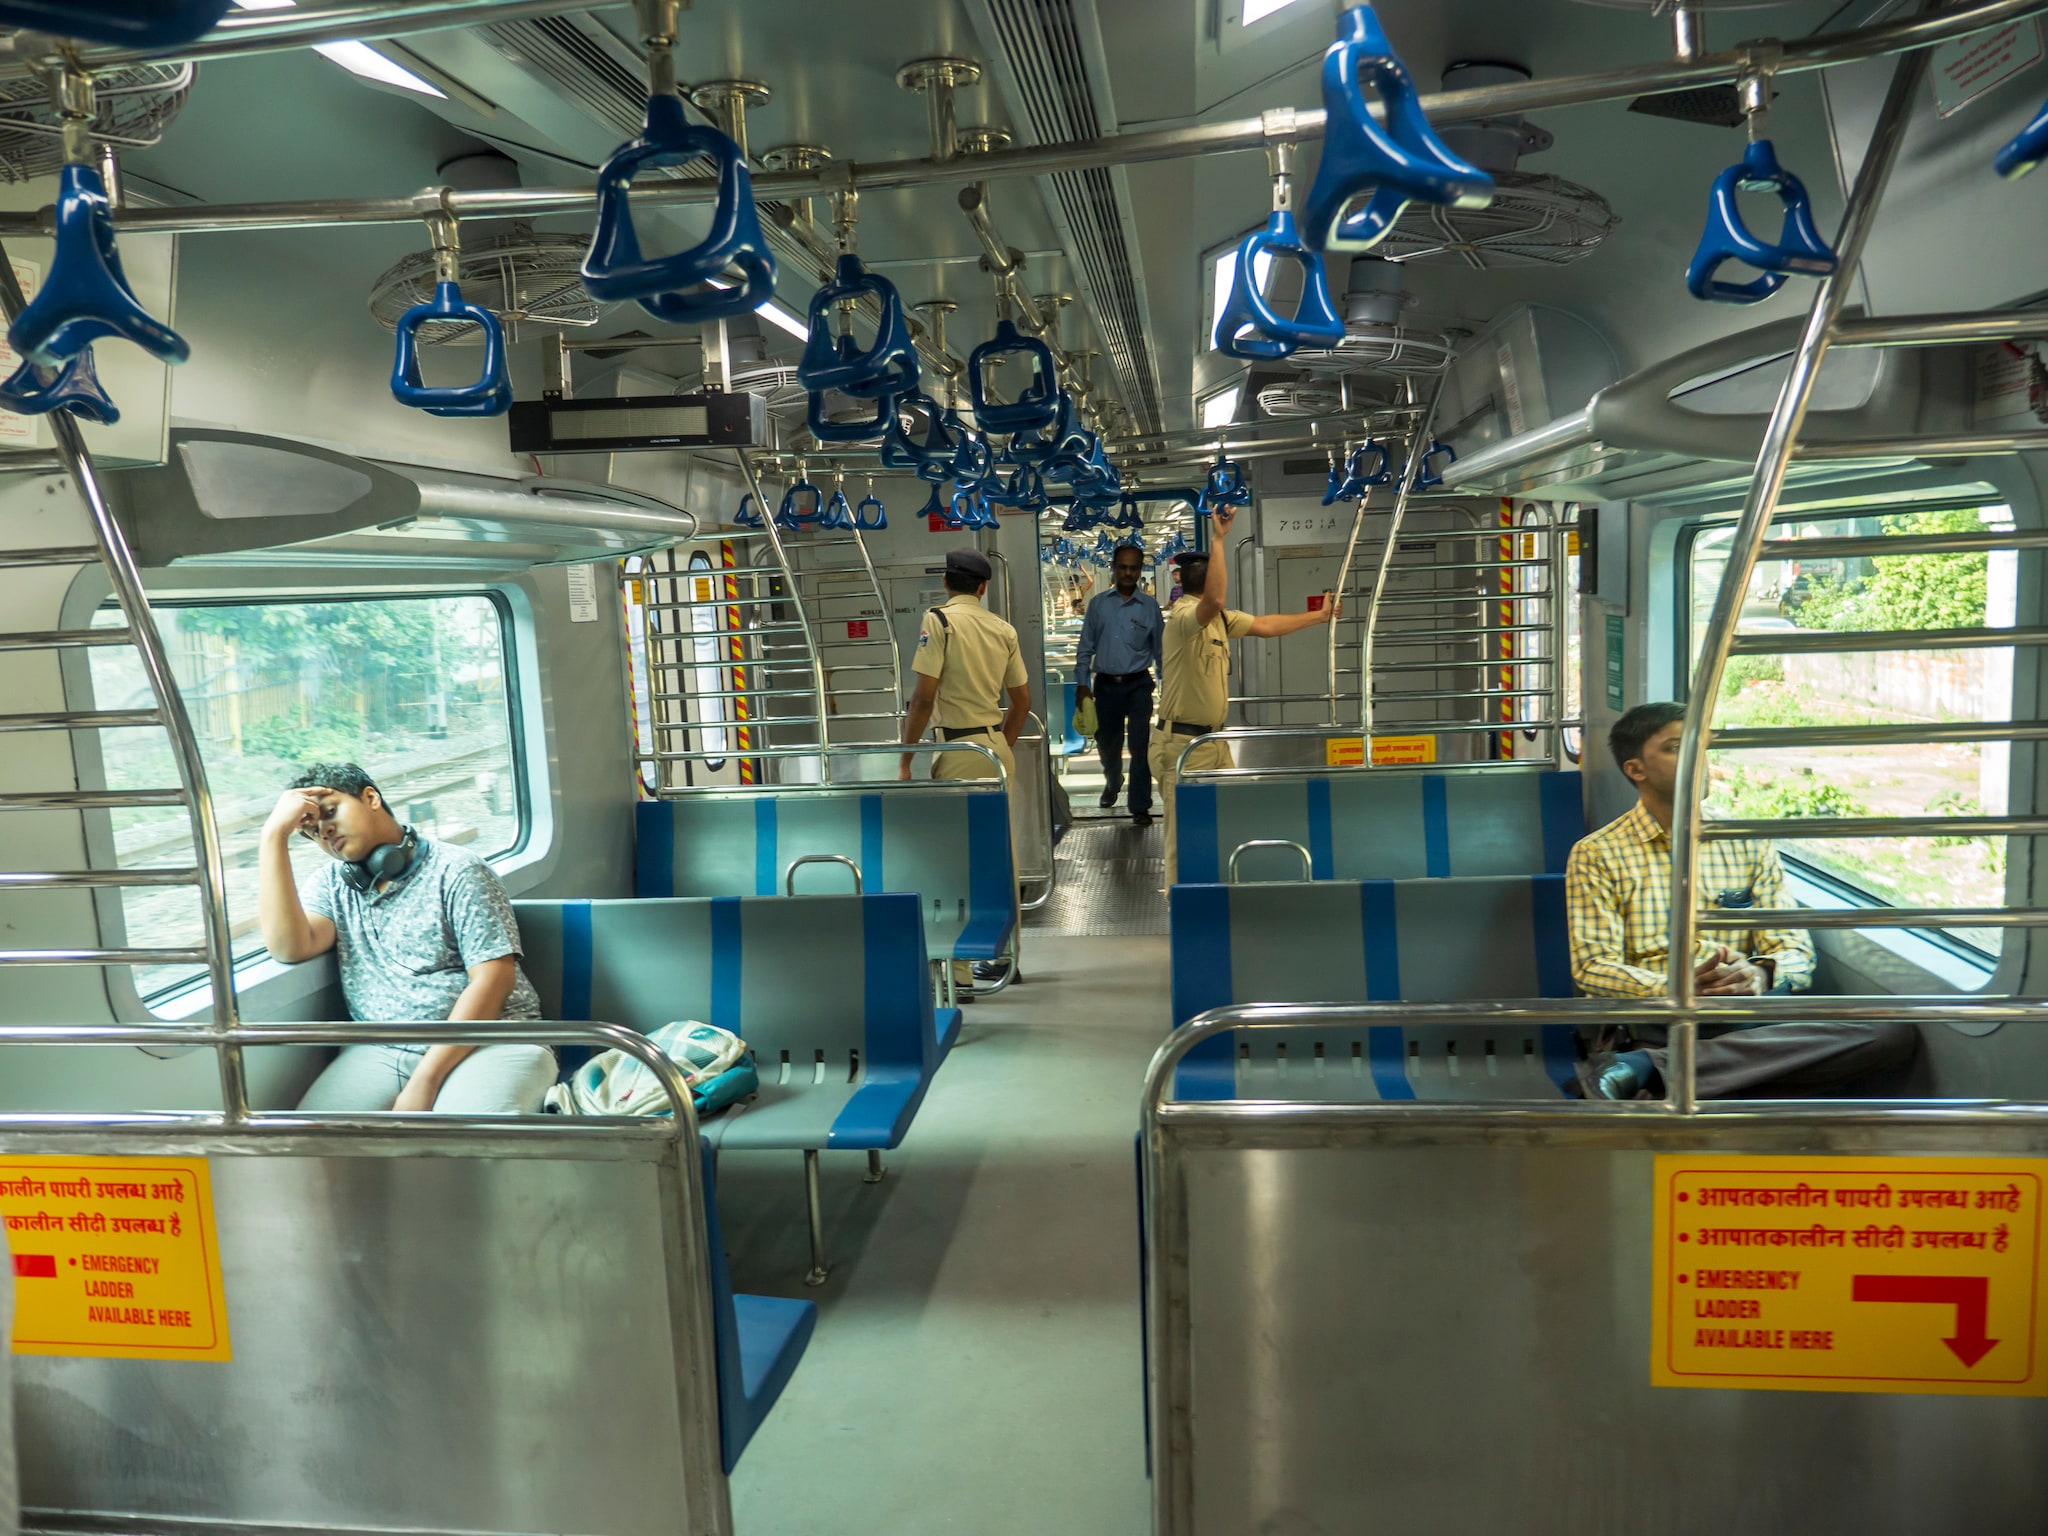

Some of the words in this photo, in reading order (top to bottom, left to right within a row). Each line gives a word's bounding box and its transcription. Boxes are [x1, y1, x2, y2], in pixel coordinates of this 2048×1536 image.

[49, 1177, 91, 1198] पायरी
[95, 1183, 147, 1199] उपलब्ध
[151, 1178, 184, 1203] आहे
[1697, 1183, 1828, 1207] आपतकालीन
[1835, 1184, 1892, 1208] पायरी
[1898, 1190, 1969, 1209] उपलब्ध
[1975, 1184, 2021, 1213] आहे
[3, 1211, 64, 1232] कालीन
[110, 1218, 165, 1234] उपलब्ध
[169, 1211, 182, 1237] है
[1697, 1224, 1845, 1247] आपातकालीन
[1911, 1231, 1988, 1249] उपलब्ध
[1992, 1223, 2009, 1253] है
[82, 1254, 159, 1274] EMERGENCY
[84, 1280, 134, 1299] LADDER
[1696, 1269, 1801, 1290] EMERGENCY
[88, 1306, 155, 1326] AVAILABLE
[158, 1310, 192, 1328] HERE
[1695, 1299, 1760, 1319] LADDER
[1694, 1328, 1784, 1349] AVAILABLE
[1789, 1330, 1834, 1350] HERE
